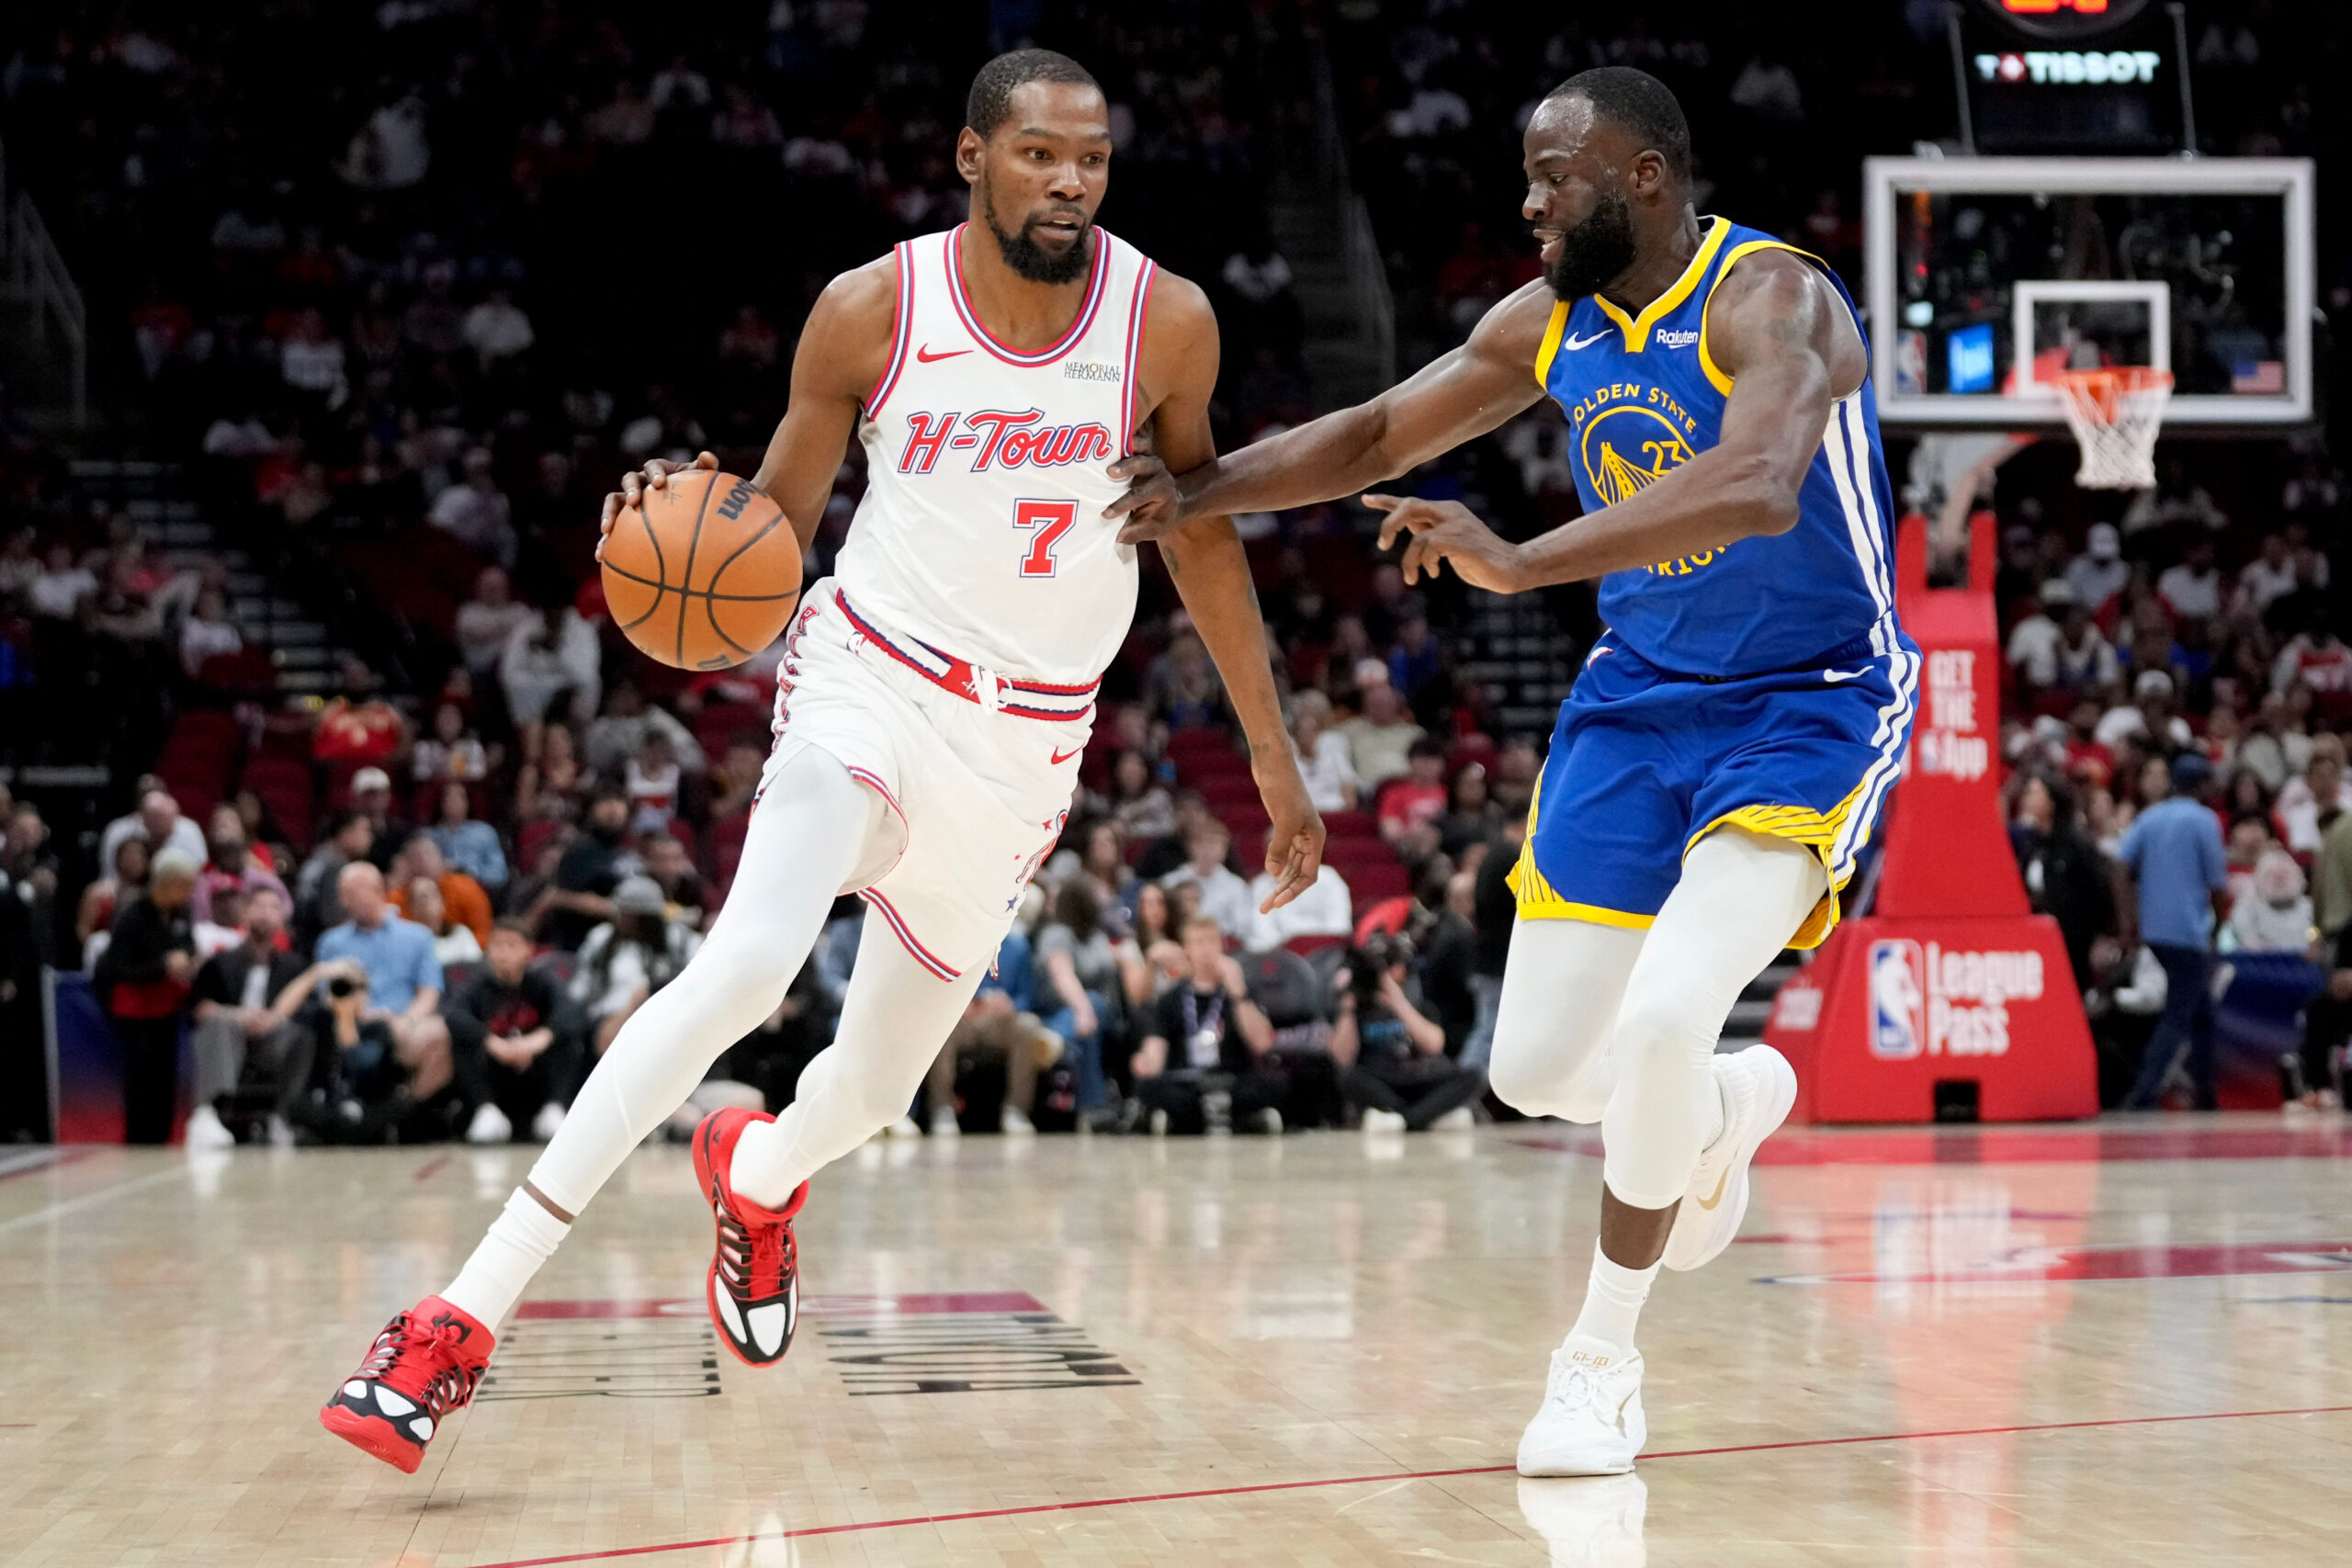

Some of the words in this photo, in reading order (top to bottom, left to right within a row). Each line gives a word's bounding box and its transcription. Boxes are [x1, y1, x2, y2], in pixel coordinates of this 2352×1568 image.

[1657, 329, 1699, 345] Rakuten
[1064, 369, 1121, 382] HERMANN
[1065, 361, 1121, 376] MEMORIAL
[1574, 383, 1641, 430] OLDEN
[1648, 387, 1698, 434] STATE
[898, 407, 1113, 474] H-Town
[1642, 440, 1689, 476] 23
[1012, 497, 1080, 578] 7
[1929, 650, 1975, 688] GET
[1926, 941, 2044, 1006] League
[1928, 997, 2010, 1055] Pass
